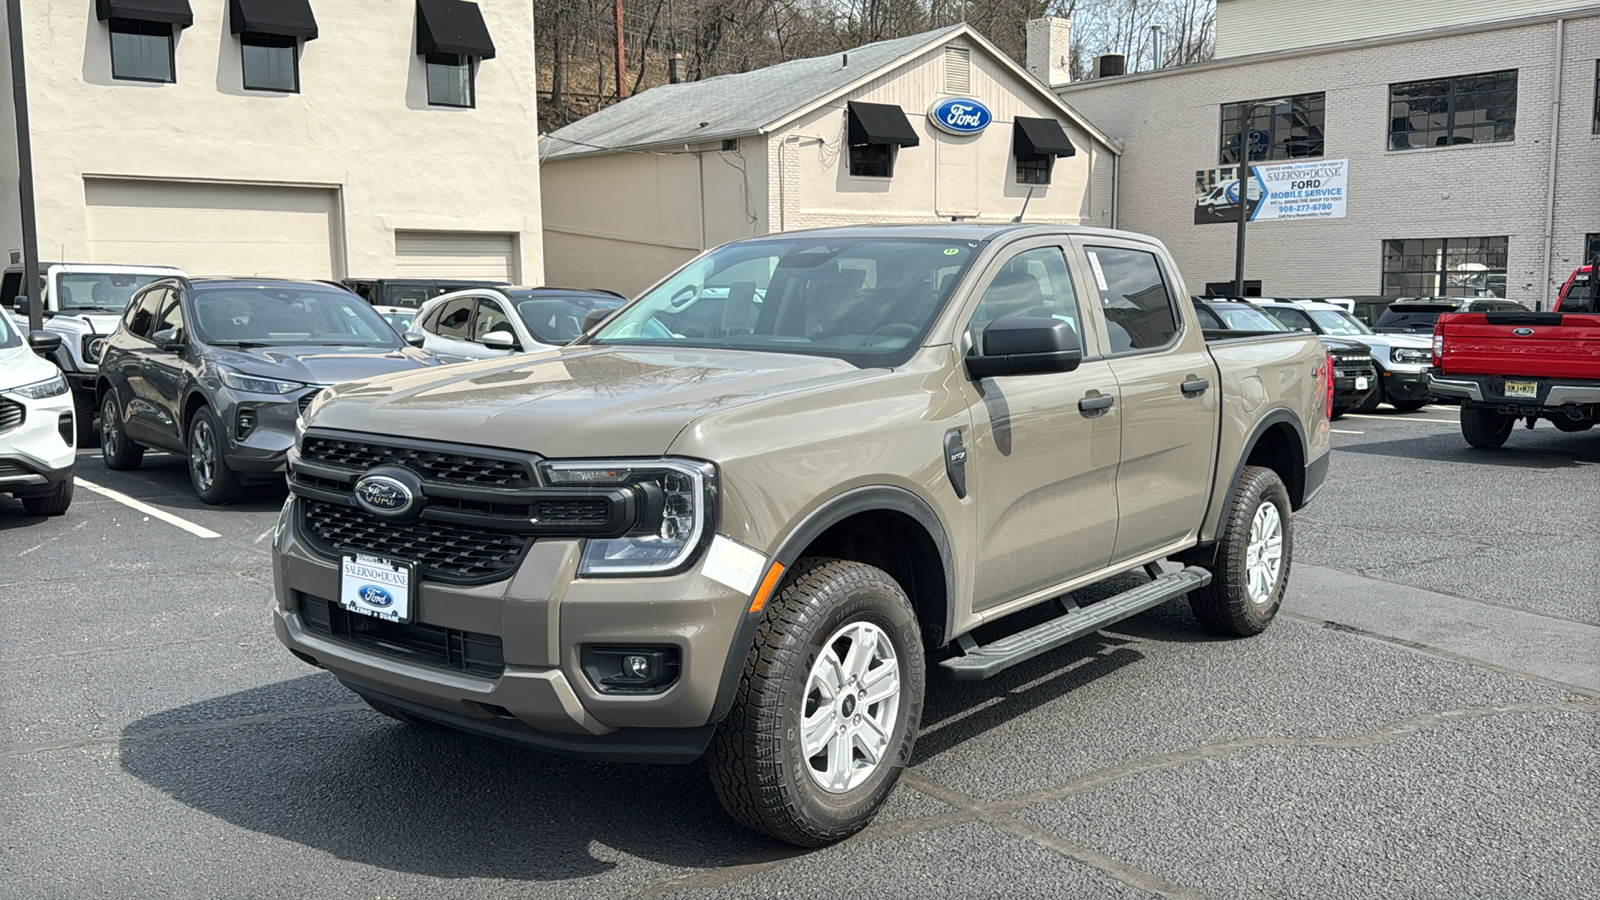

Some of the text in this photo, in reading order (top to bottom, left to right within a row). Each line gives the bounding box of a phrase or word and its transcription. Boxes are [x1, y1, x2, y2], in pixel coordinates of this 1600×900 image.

[946, 103, 982, 127] Ford
[1267, 167, 1342, 181] SALERNO DUANE
[1270, 188, 1343, 200] MOBILE SERVICE
[1291, 180, 1321, 190] FORD
[1279, 203, 1333, 213] 908-277-6780
[364, 482, 397, 506] Ford
[344, 563, 408, 586] SALERNO DUANE
[364, 587, 388, 605] Ford
[345, 604, 400, 623] SALERNO DUANE
